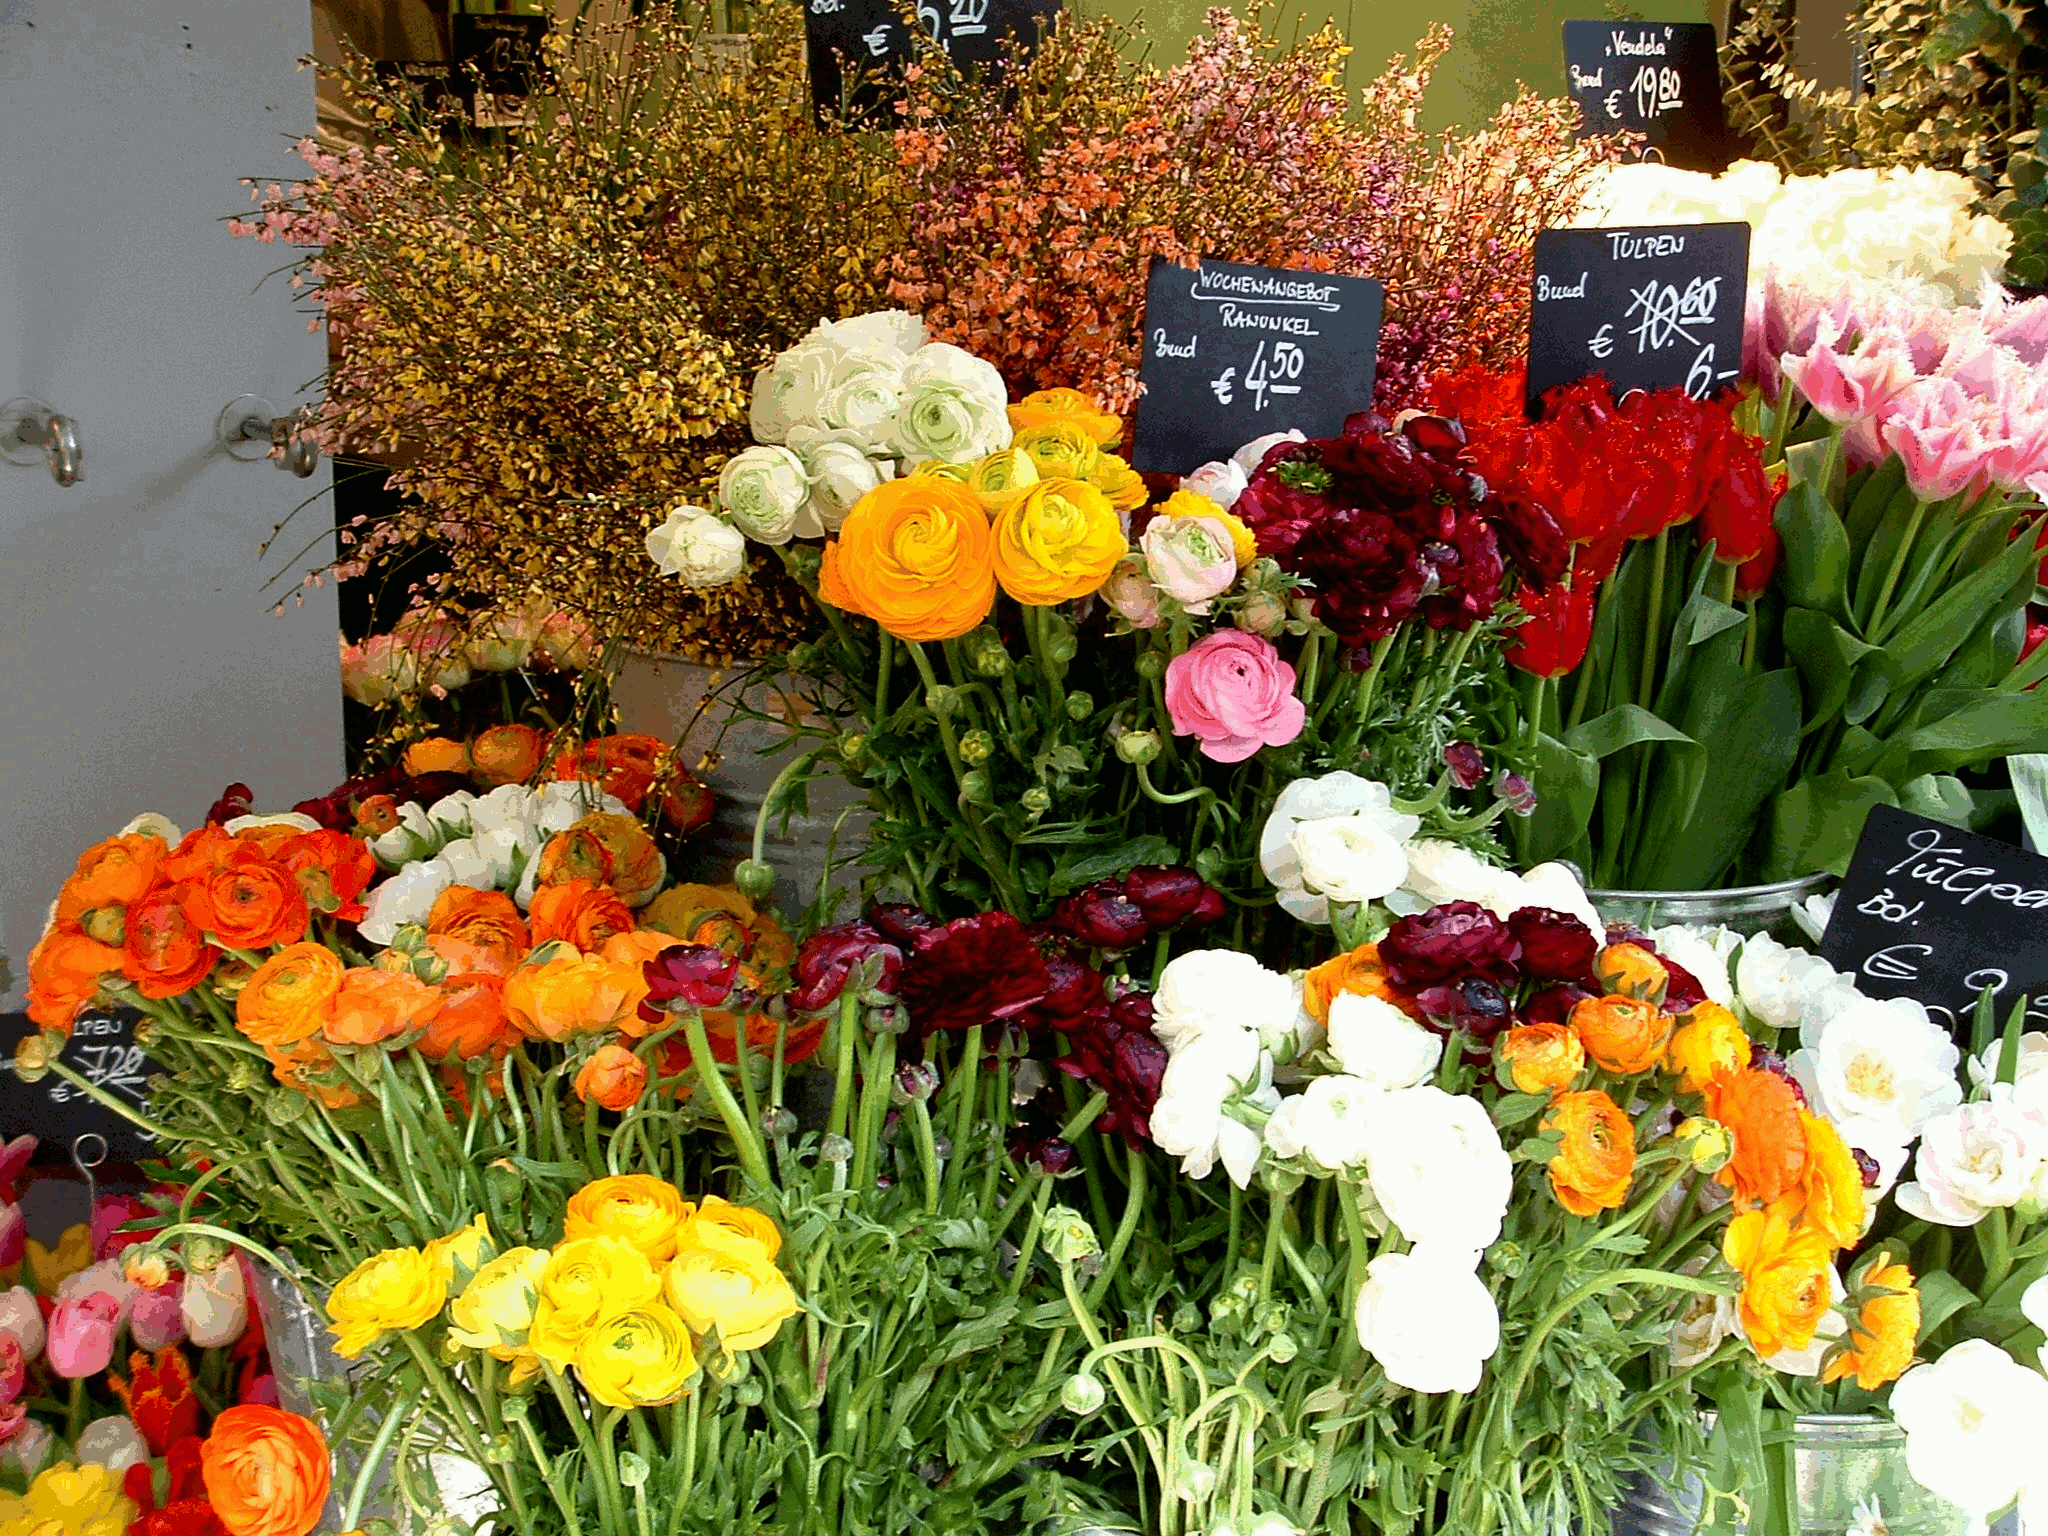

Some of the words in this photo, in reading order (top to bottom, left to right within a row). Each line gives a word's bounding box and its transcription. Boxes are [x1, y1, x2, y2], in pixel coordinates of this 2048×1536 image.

[862, 24, 892, 57] €
[1603, 89, 1624, 119] €
[1629, 65, 1684, 119] 19.80
[1606, 231, 1685, 260] TULPEN
[1199, 266, 1340, 302] WOCHENANGEBOT
[1536, 272, 1589, 302] Bund
[1219, 302, 1320, 336] RANUNKEL
[1587, 324, 1614, 358] €
[1210, 367, 1236, 405] €
[1244, 340, 1305, 411] 4.50
[1863, 945, 1934, 980] €
